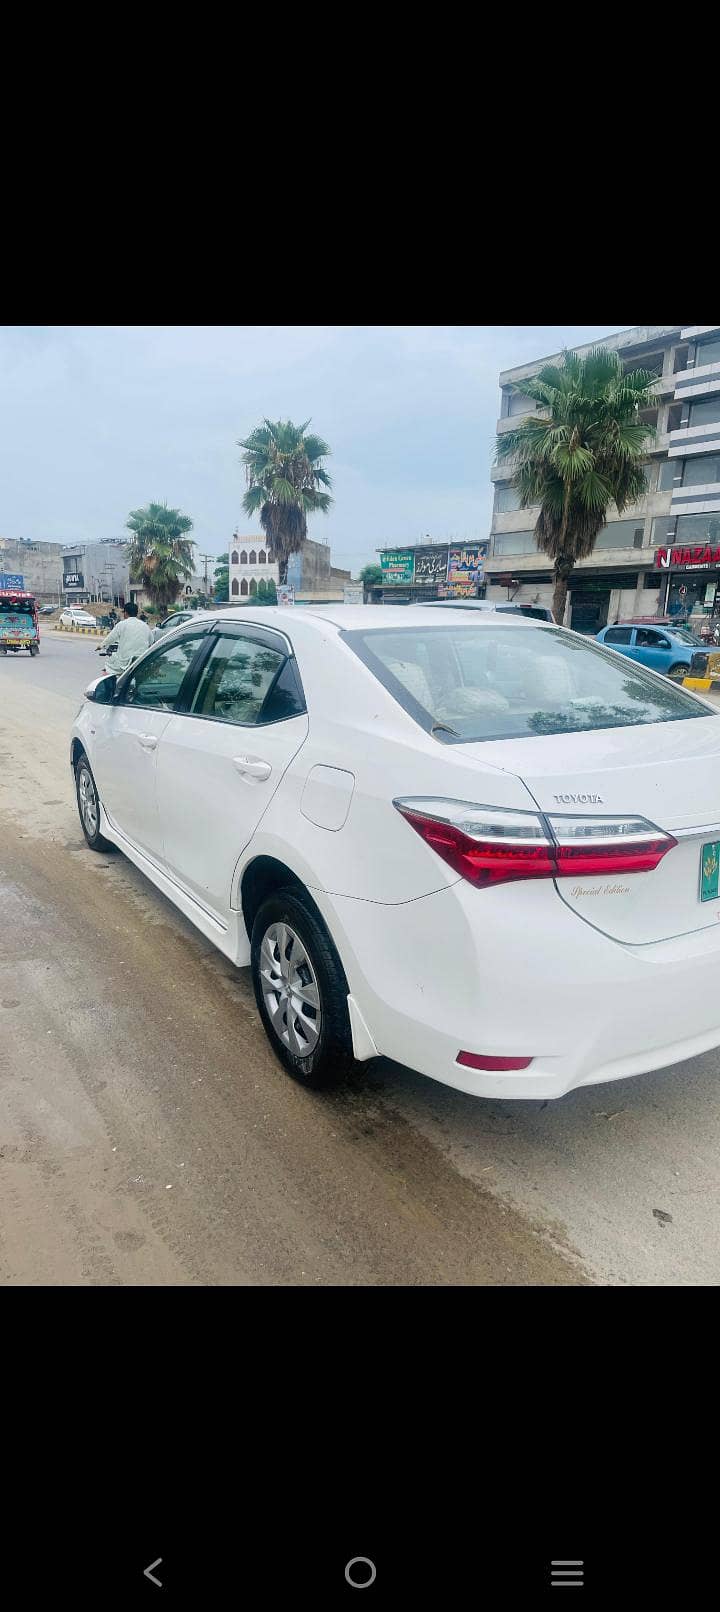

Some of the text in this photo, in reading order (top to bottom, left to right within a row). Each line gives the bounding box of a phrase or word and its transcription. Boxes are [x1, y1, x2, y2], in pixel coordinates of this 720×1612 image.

[553, 794, 604, 804] TOYOTA
[570, 883, 631, 899] Special Edition
